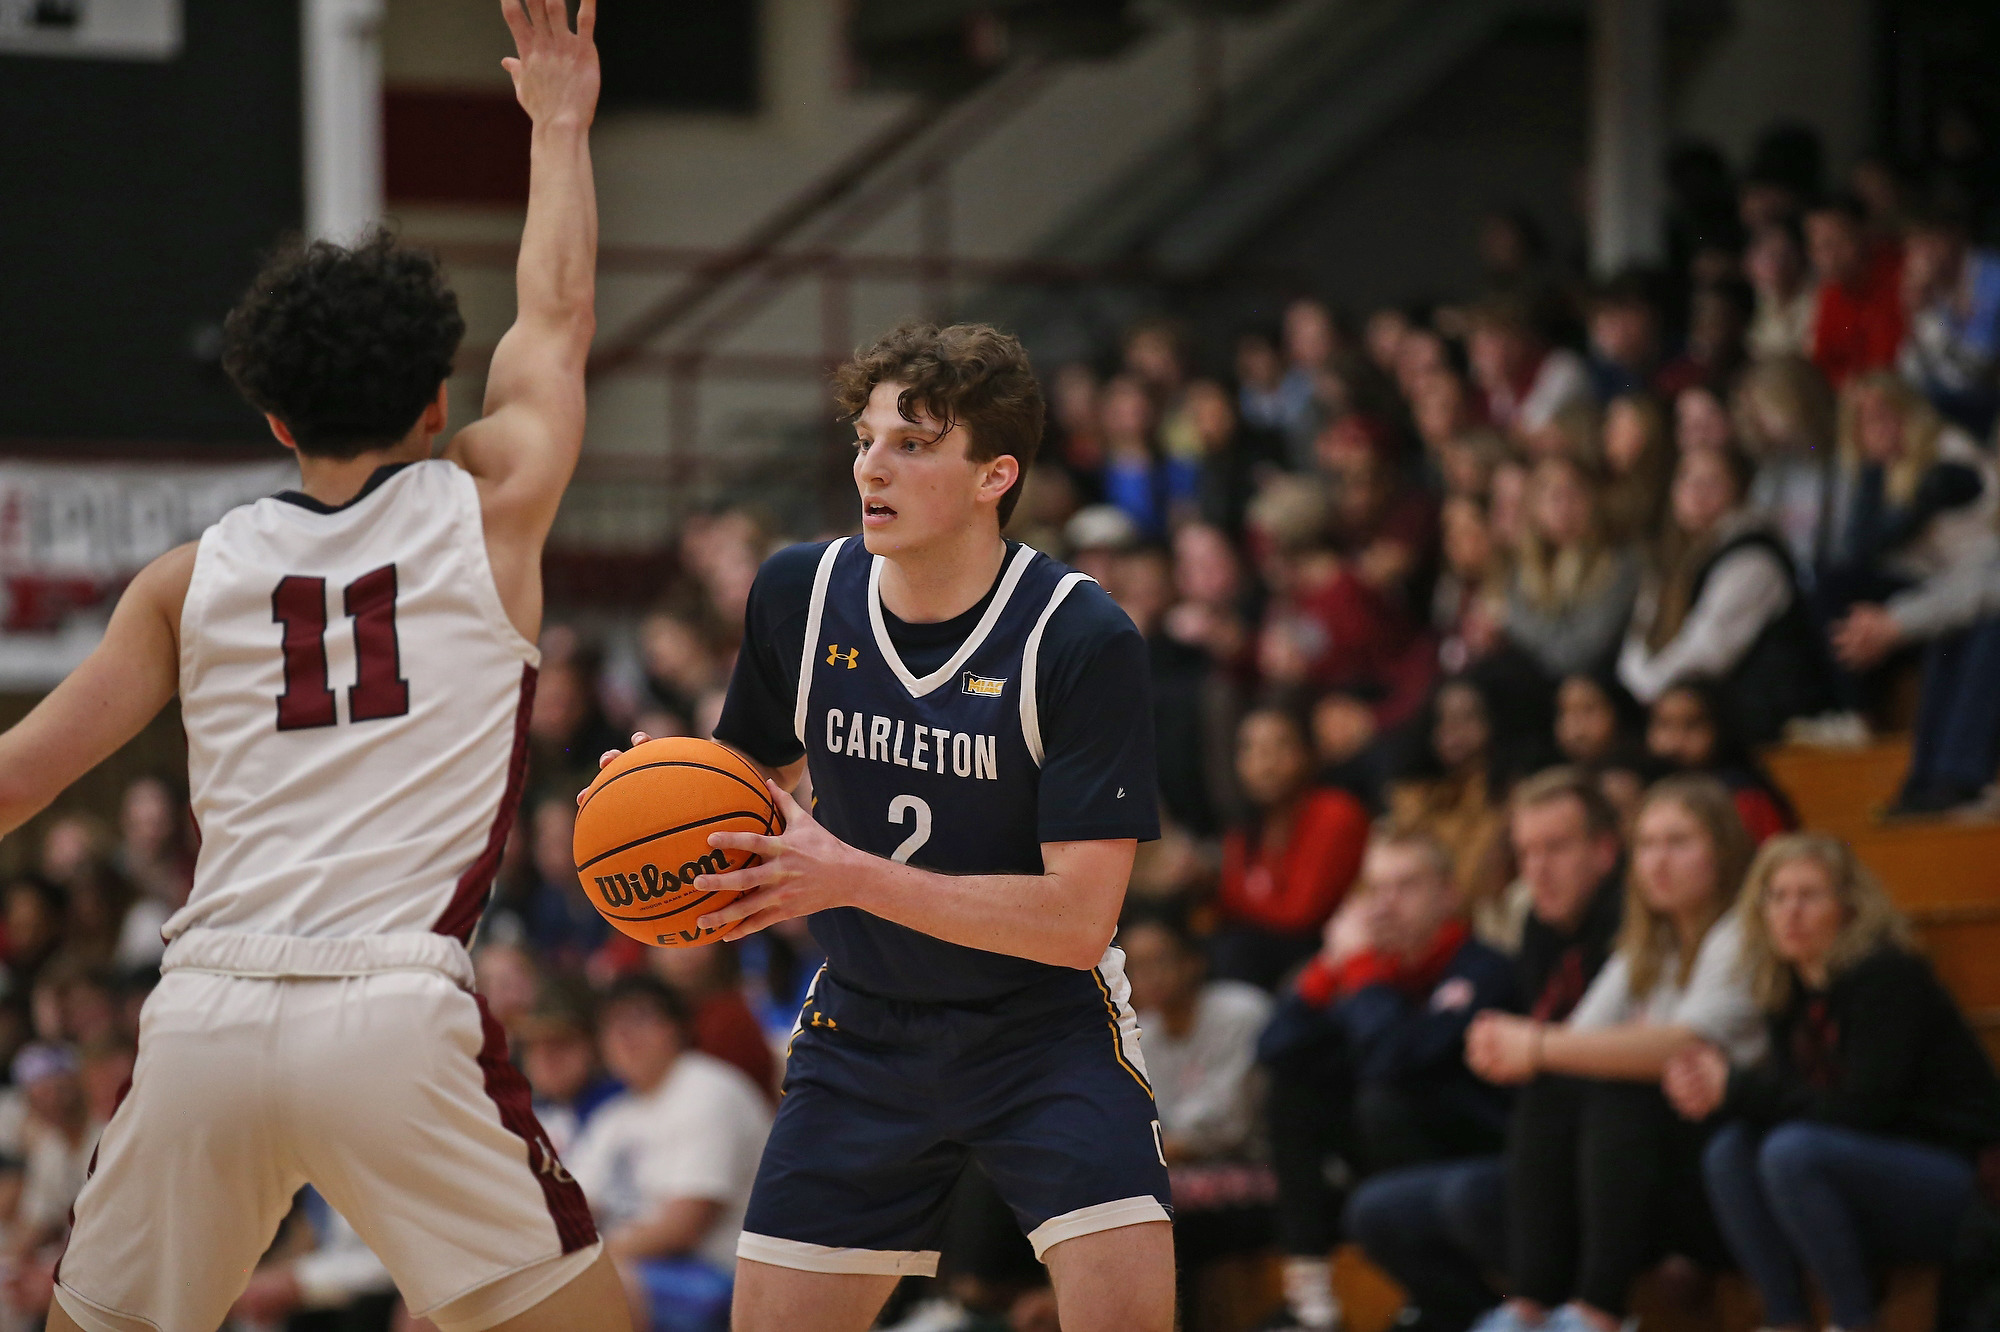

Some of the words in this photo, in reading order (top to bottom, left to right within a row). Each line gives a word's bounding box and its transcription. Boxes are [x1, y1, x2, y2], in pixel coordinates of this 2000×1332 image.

[271, 562, 409, 731] 11
[968, 678, 1004, 693] MIAC
[826, 708, 998, 780] CARLETON
[888, 794, 932, 865] 2
[594, 848, 731, 908] Wilson
